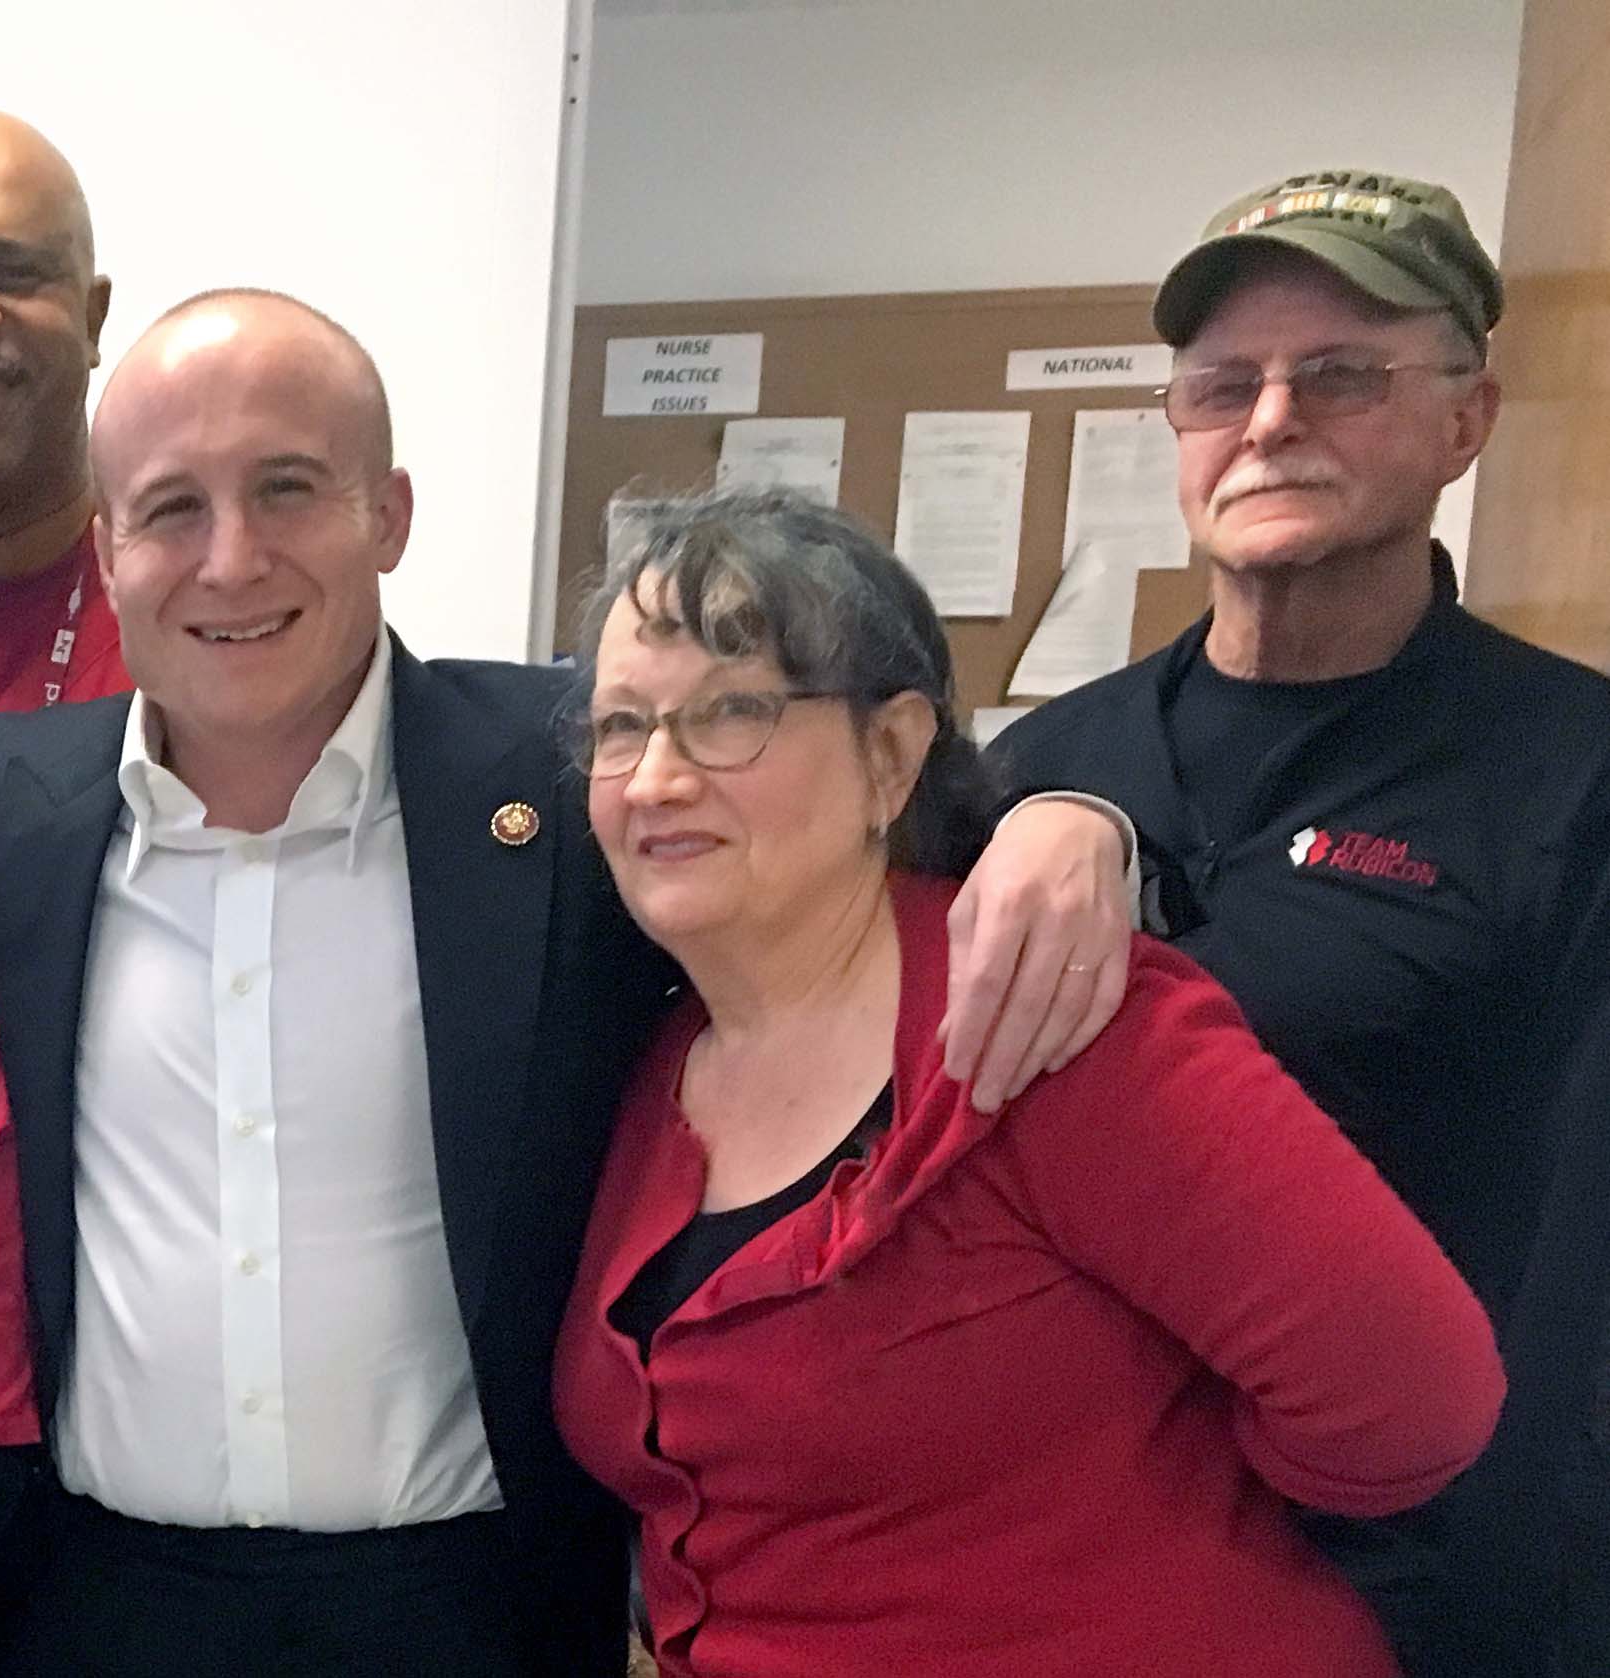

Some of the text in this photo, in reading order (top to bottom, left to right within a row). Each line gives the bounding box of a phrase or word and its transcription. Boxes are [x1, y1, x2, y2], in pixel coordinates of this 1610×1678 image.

[655, 339, 712, 355] NURSE
[1043, 356, 1134, 374] NATIONAL
[642, 367, 723, 383] PRACTICE
[651, 396, 709, 412] ISSUES
[1342, 831, 1409, 863] TEAM
[1329, 848, 1437, 886] RUBICON
